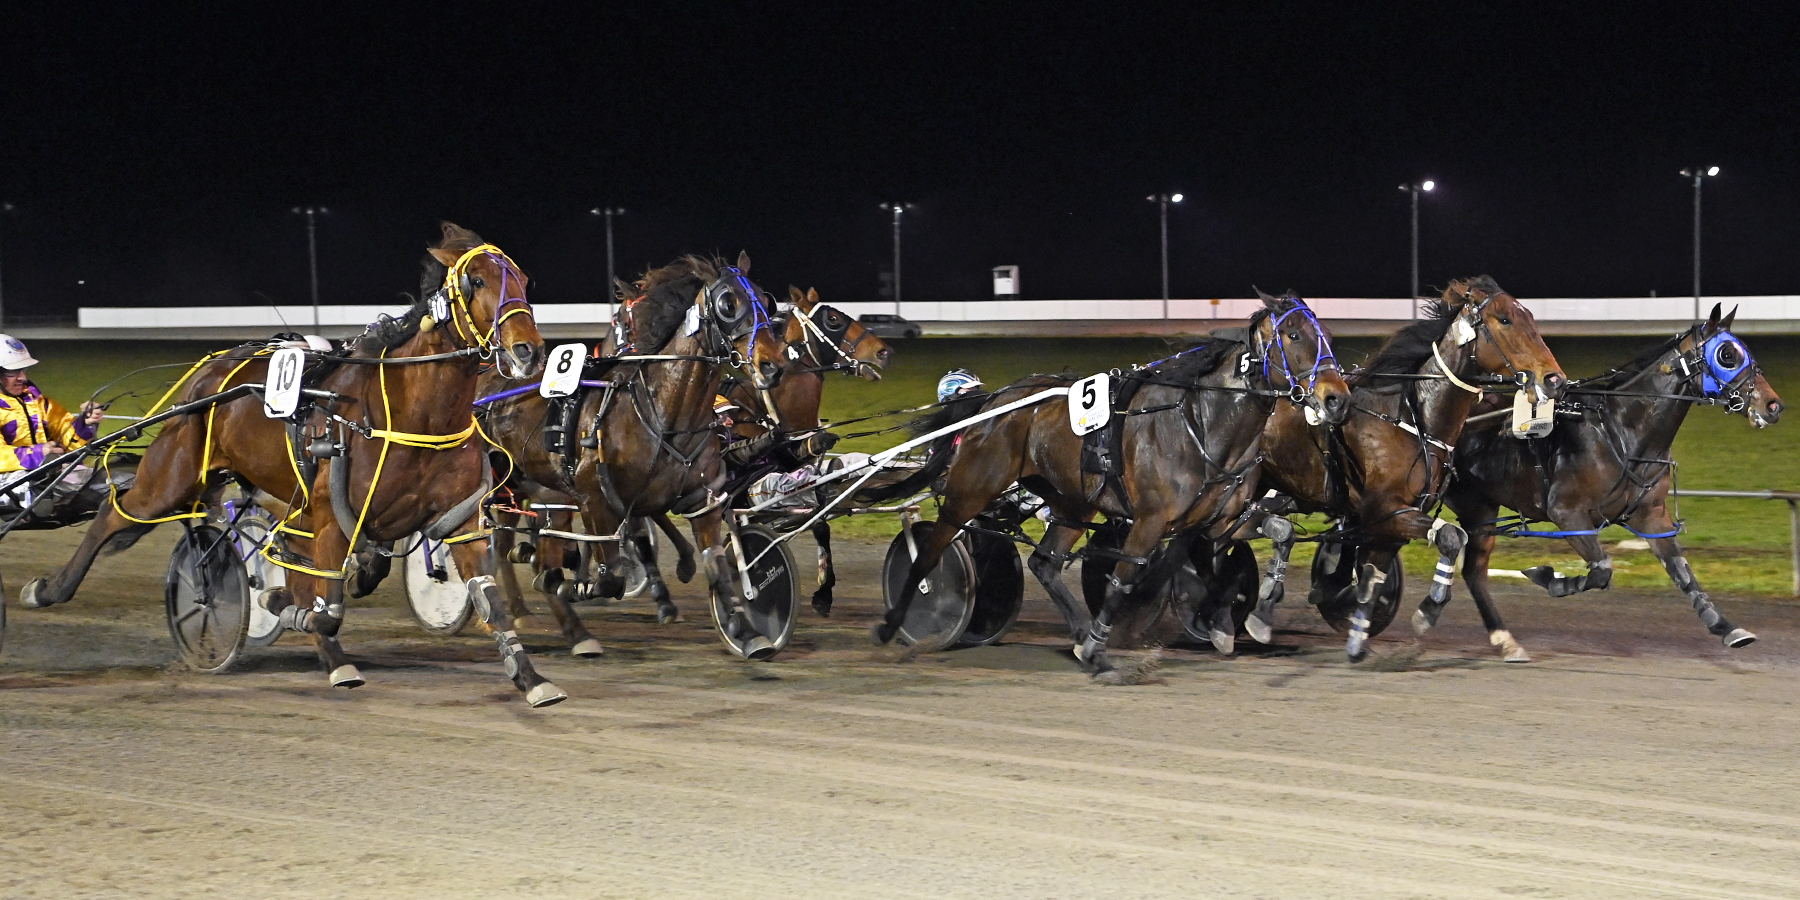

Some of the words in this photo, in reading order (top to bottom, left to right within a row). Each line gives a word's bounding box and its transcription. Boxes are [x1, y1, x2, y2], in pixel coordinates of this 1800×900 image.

[431, 296, 446, 323] 10
[615, 327, 624, 345] 2
[557, 349, 573, 374] 8
[788, 345, 799, 360] 4
[1240, 352, 1250, 373] 5
[276, 353, 297, 391] 10
[1082, 379, 1095, 410] 5
